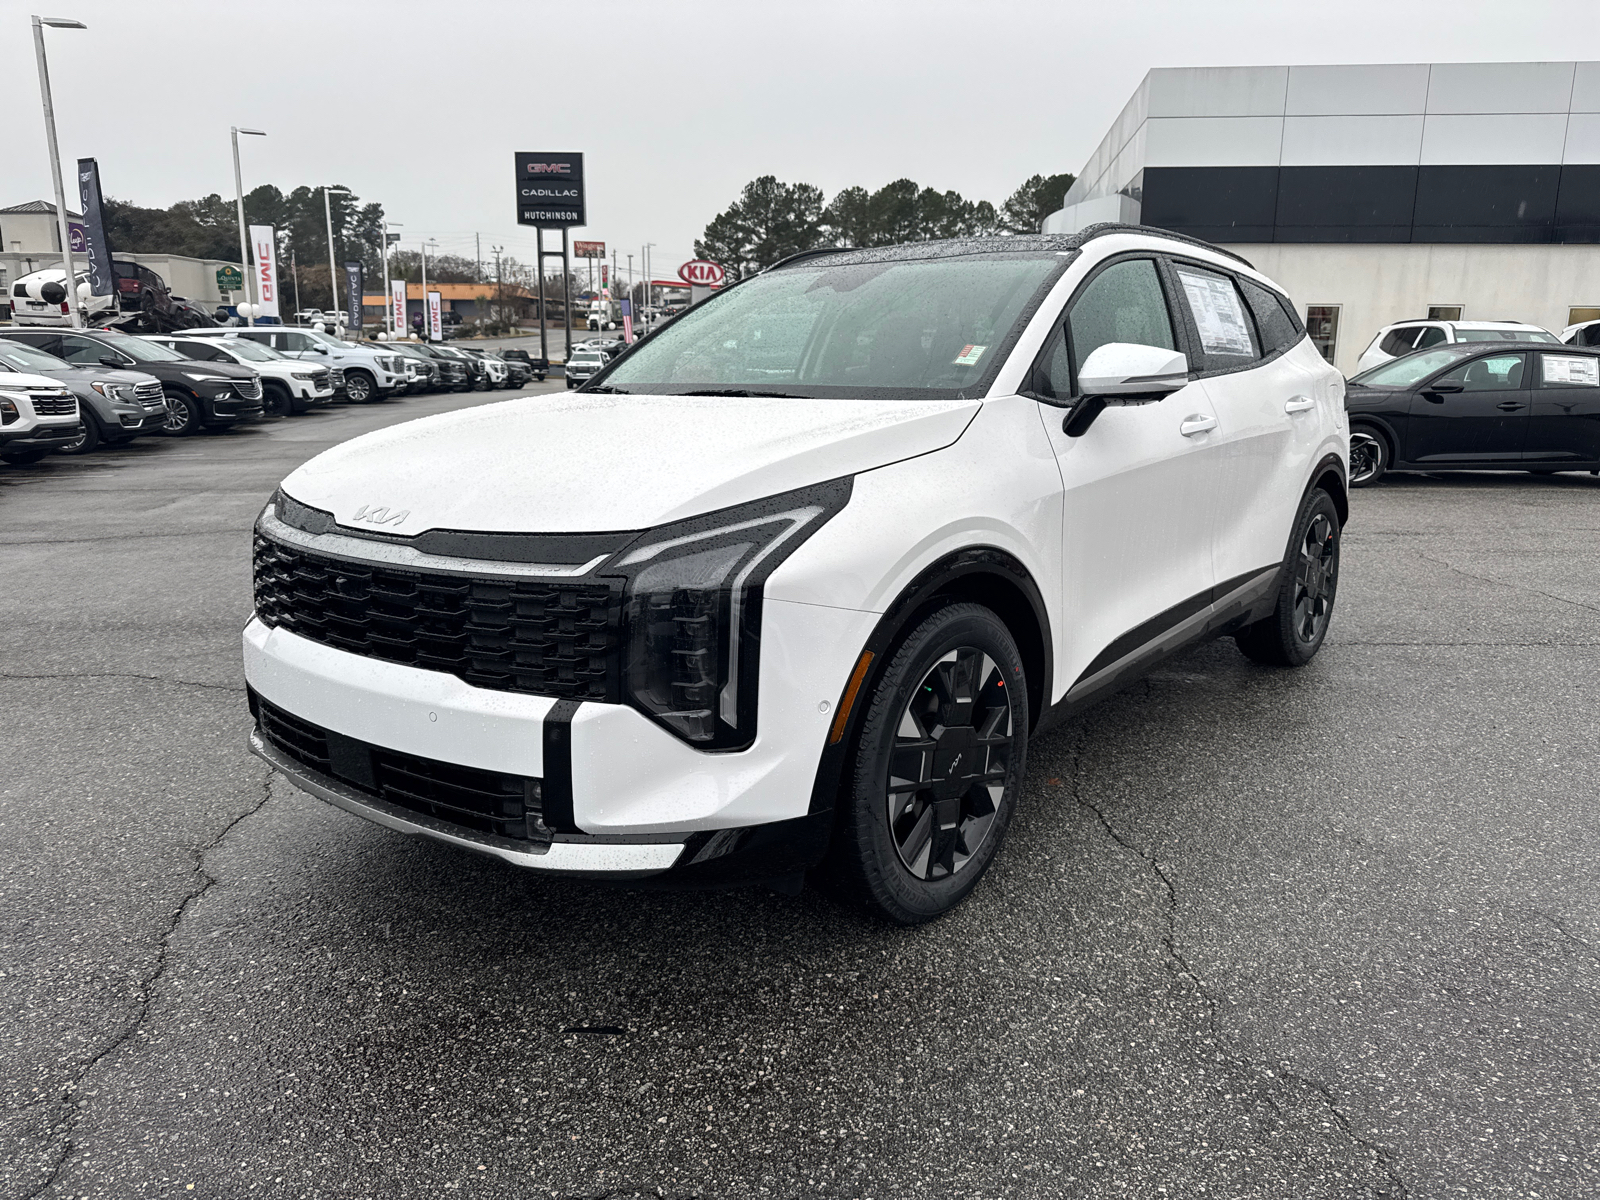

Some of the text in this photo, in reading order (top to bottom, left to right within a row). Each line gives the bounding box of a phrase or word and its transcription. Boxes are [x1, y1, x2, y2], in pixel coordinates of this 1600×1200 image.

[527, 163, 571, 173] GMC
[521, 189, 579, 197] CADILLAC
[524, 211, 578, 220] HUTCHINSON
[687, 265, 718, 280] KIA
